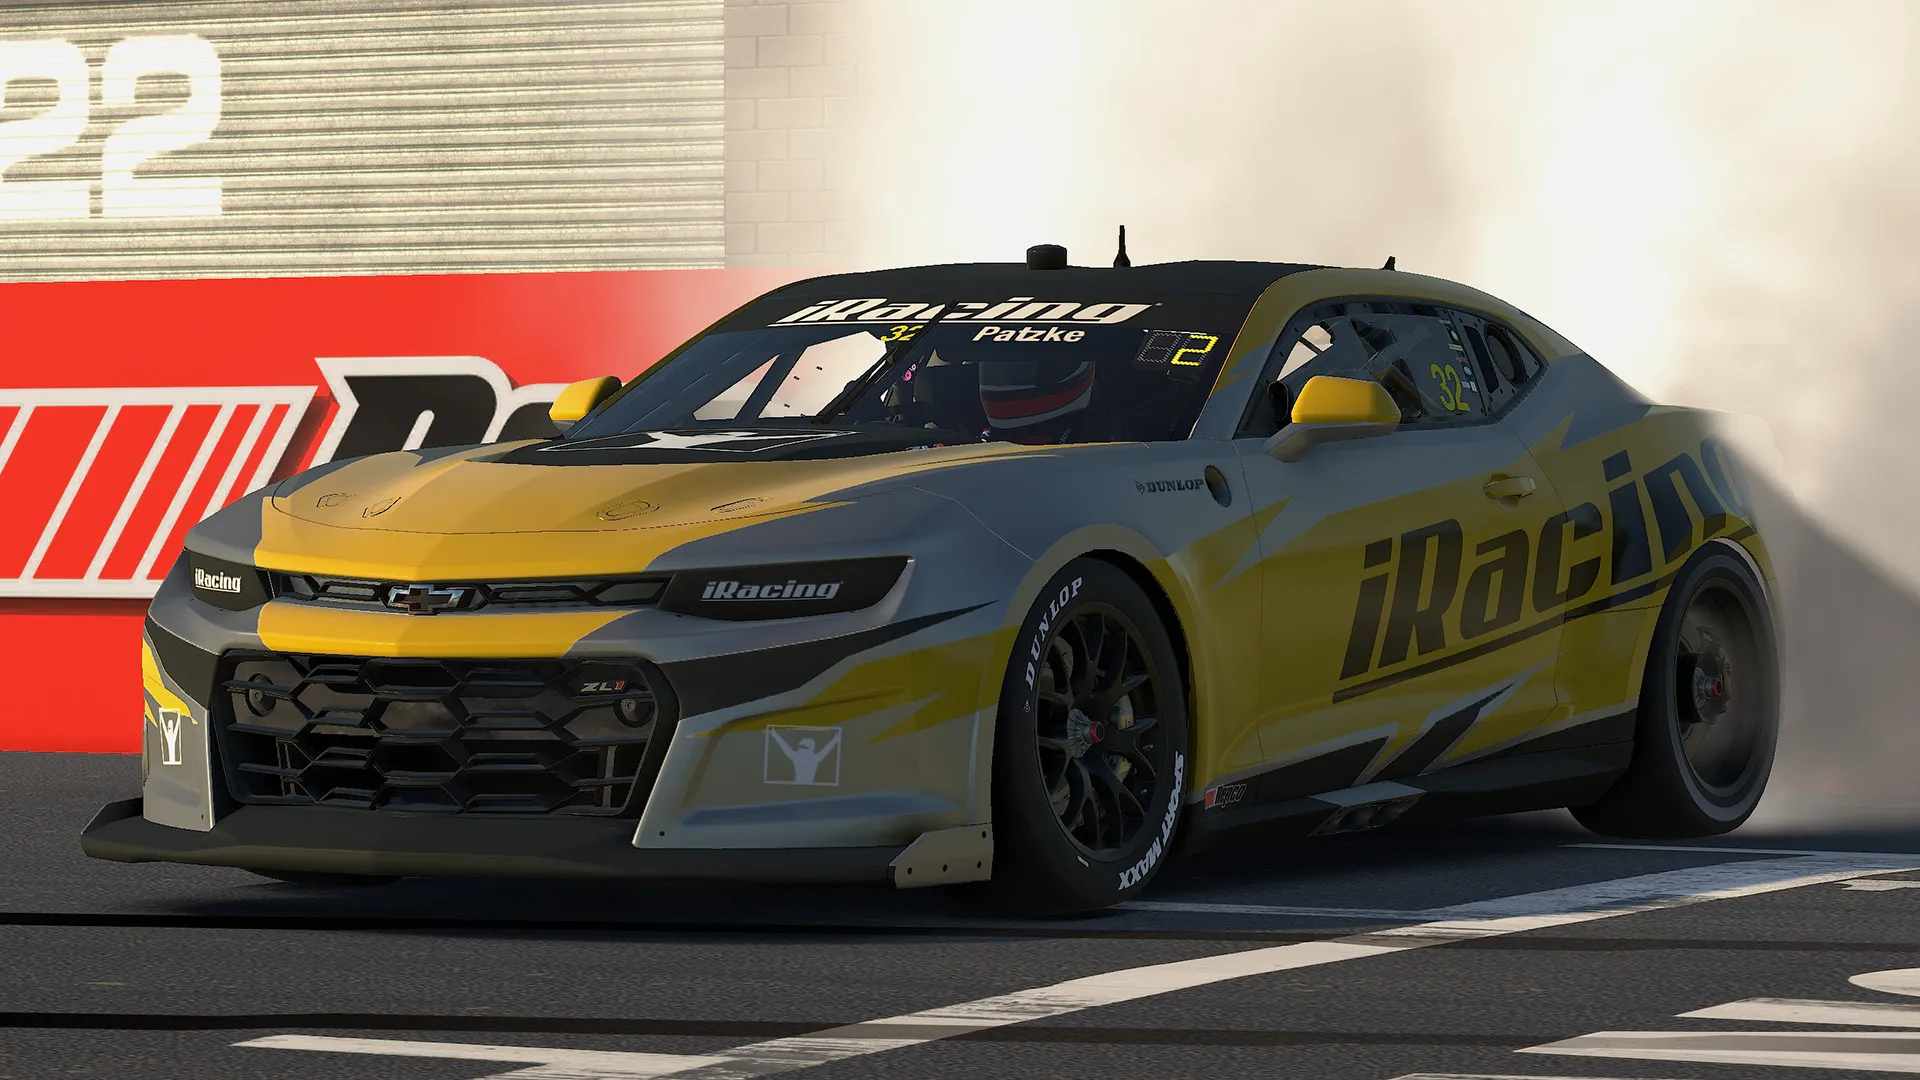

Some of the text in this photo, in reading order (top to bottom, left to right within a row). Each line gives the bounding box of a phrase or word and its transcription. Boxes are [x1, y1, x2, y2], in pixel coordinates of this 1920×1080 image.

[768, 297, 1152, 326] iRacing
[972, 325, 1086, 343] Patzke
[1430, 363, 1471, 412] 32
[1147, 479, 1205, 493] DUNLOP
[194, 567, 242, 594] iRacing
[700, 579, 844, 601] iRacing
[1025, 576, 1083, 692] DUNLOP
[580, 680, 627, 693] ZL1
[1117, 750, 1184, 891] SPORT MAXX
